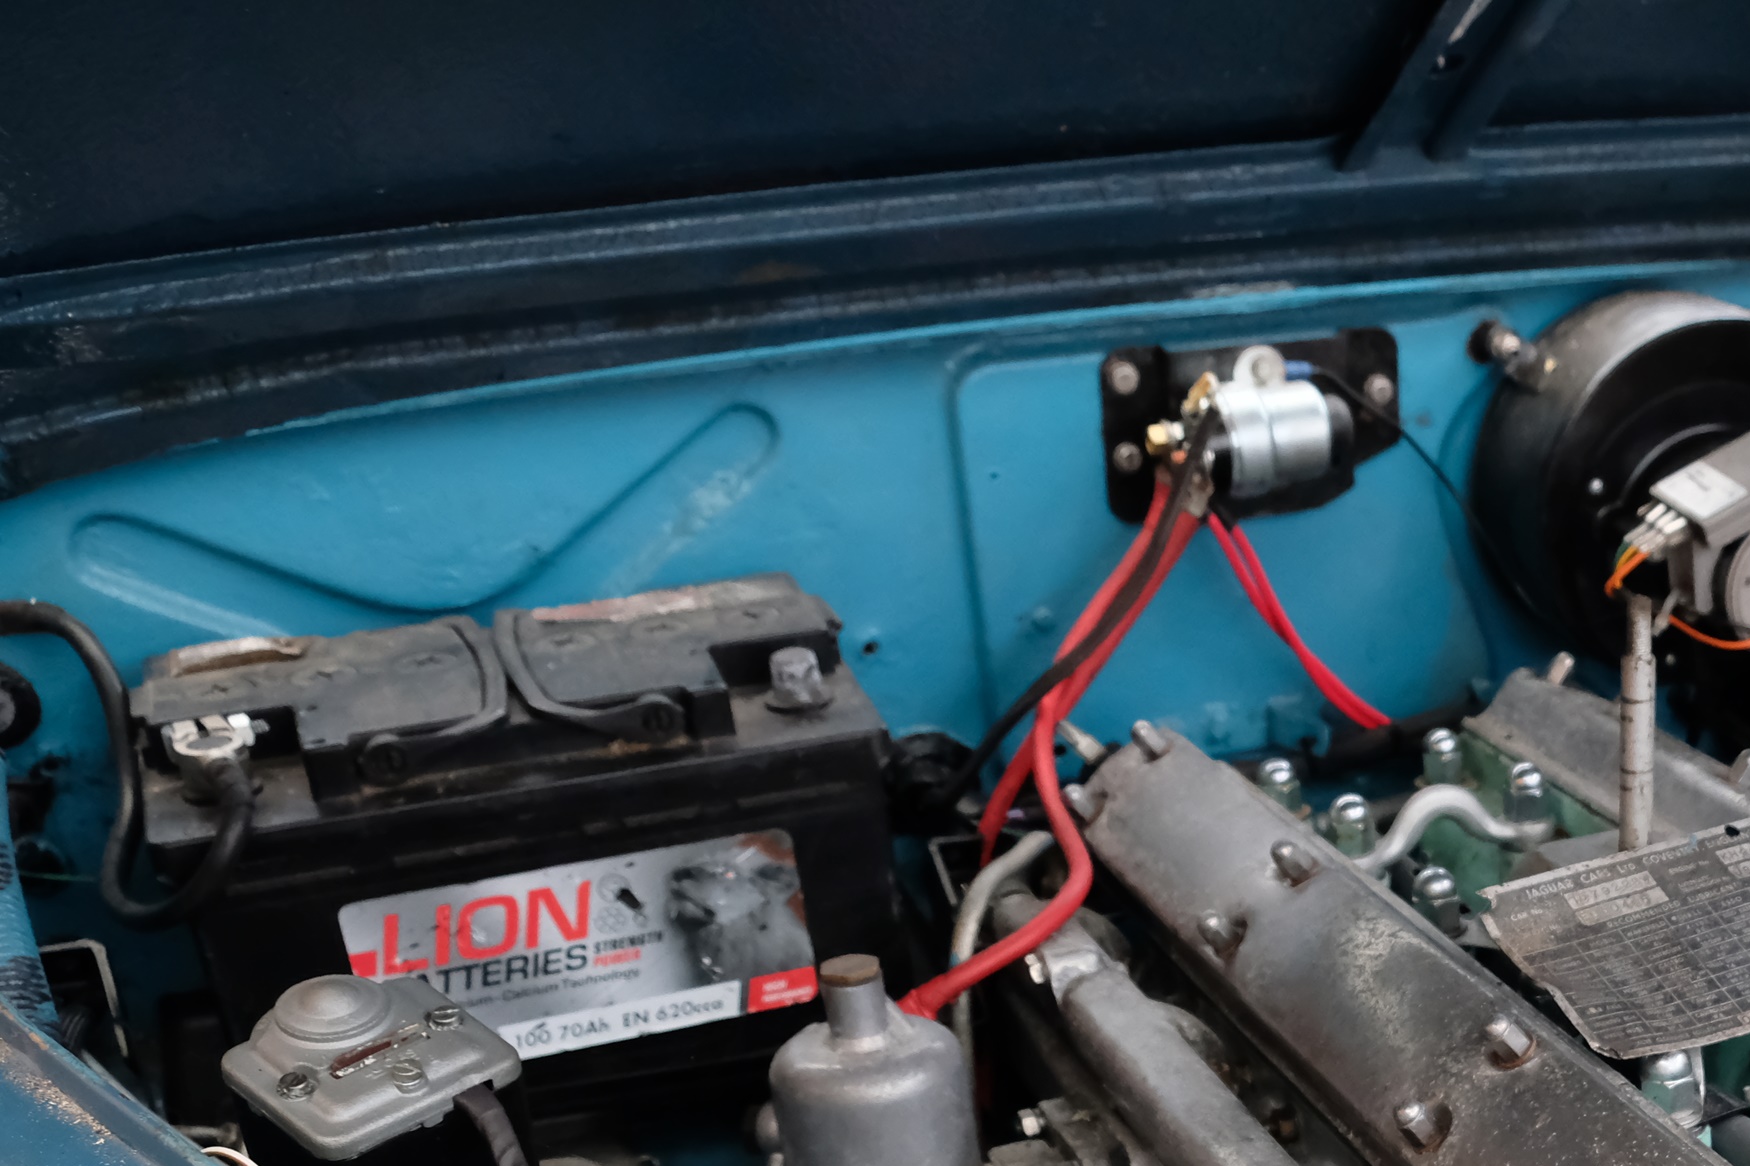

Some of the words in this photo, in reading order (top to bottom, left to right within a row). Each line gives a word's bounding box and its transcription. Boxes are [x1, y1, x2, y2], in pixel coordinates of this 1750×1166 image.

[1526, 878, 1575, 899] JAGUAR
[382, 880, 592, 976] LION
[416, 944, 587, 994] TTERIES
[621, 1010, 650, 1029] EN
